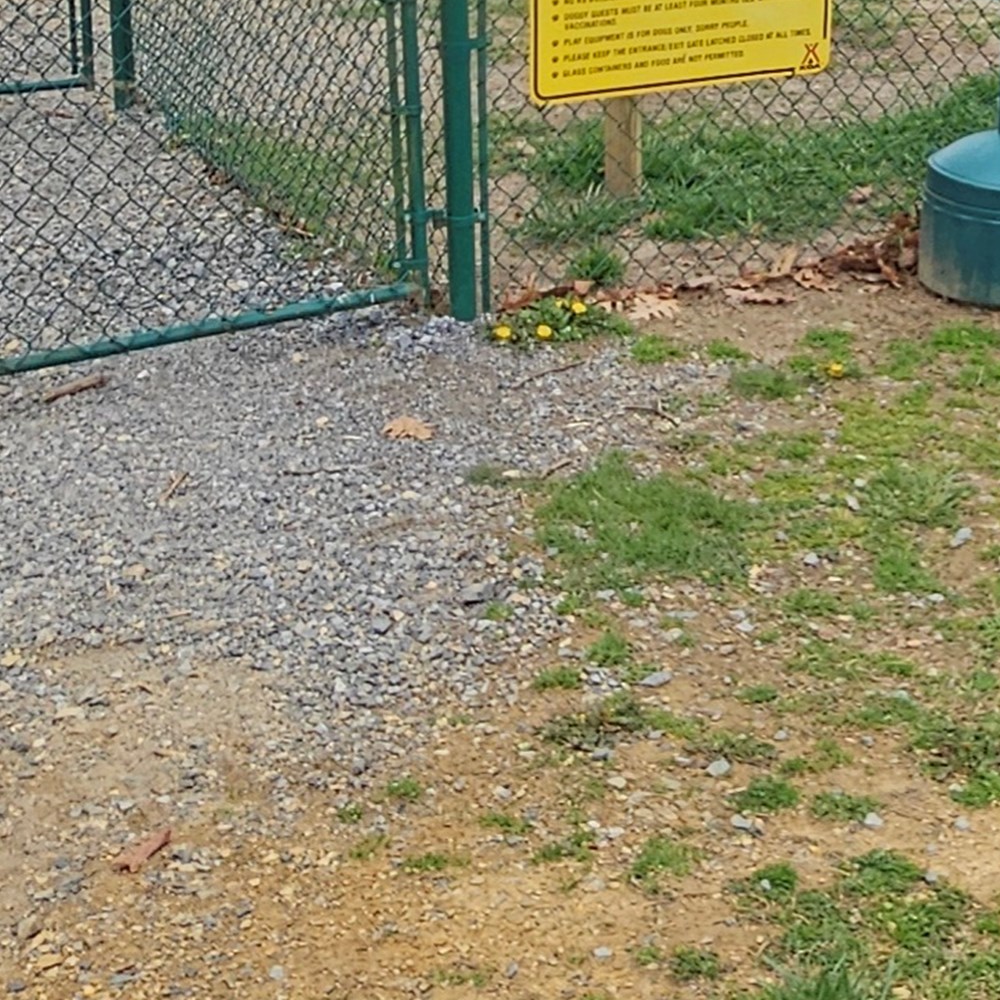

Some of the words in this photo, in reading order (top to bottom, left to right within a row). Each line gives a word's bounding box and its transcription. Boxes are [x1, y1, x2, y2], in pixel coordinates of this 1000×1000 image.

[654, 3, 662, 11] AT
[665, 1, 686, 10] LEAST
[563, 37, 582, 46] PLAY
[636, 29, 650, 38] FOR
[563, 52, 590, 62] PLEASE
[592, 49, 611, 59] KEEP
[614, 47, 626, 55] THE
[706, 36, 736, 46] LATCHED
[634, 60, 649, 69] AND
